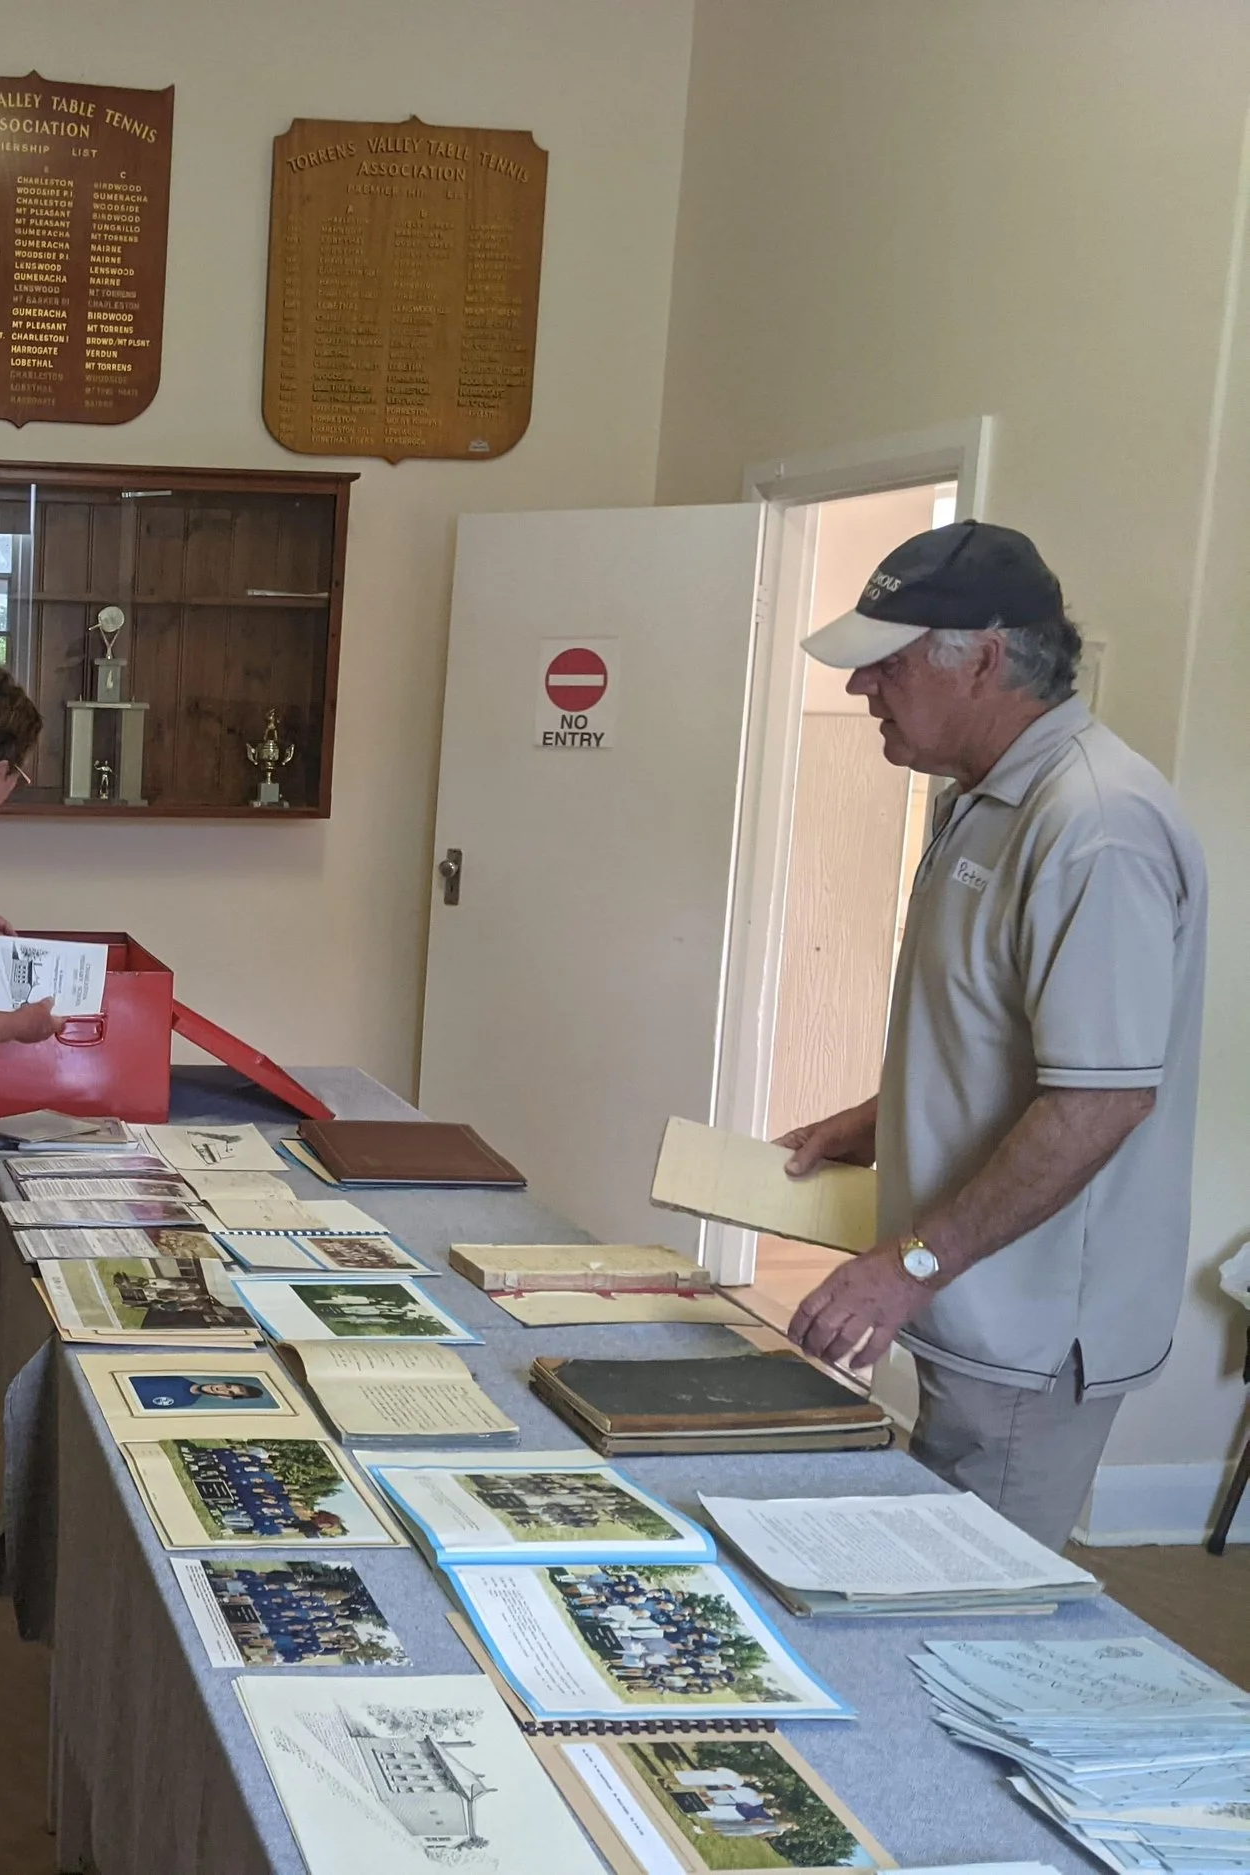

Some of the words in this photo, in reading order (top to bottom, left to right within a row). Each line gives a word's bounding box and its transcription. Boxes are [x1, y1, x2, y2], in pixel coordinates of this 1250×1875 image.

[51, 95, 96, 118] TABLE
[105, 108, 158, 144] TENNIS
[71, 147, 98, 159] LIST
[286, 140, 357, 174] TORRENS
[367, 136, 424, 154] VALLEY
[426, 139, 470, 162] TABLE
[480, 150, 531, 184] TENNIS
[120, 171, 127, 179] C
[356, 160, 467, 182] ASSOCIATION
[16, 176, 74, 187] CHARLESTON
[16, 197, 73, 208] CHARLESTON
[93, 192, 148, 203] GUMERACHA
[15, 207, 29, 215] MT
[30, 208, 71, 218] PLEASANT
[15, 217, 27, 225] MT
[29, 218, 71, 228] PLEASANT
[14, 228, 70, 238] GUMERACHA
[14, 238, 70, 249] GUMERACHA
[90, 244, 122, 253] NAIRNE
[14, 250, 57, 260] WOODSIDE
[90, 255, 122, 264] NAIRNE
[14, 262, 62, 272] LENSWOOD
[89, 266, 135, 276] LENSWOOD
[13, 272, 68, 283] GUMERACHA
[89, 277, 121, 287] NAIRNE
[13, 284, 60, 294] LENSWOOD
[12, 307, 68, 319] GUMERACHA
[87, 311, 134, 322] BIRDWOOD
[12, 321, 23, 329] MT
[25, 321, 67, 331] PLEASANT
[86, 324, 98, 333] MT
[100, 325, 134, 334] TORRENS
[11, 332, 65, 343] CHARLESTON
[10, 345, 59, 356] HARROGATE
[85, 349, 118, 358] VERDUN
[10, 358, 54, 368] LOBETHAL
[85, 361, 96, 370] MT
[98, 362, 132, 372] TORRENS
[560, 714, 588, 730] NO
[542, 731, 605, 748] ENTRY
